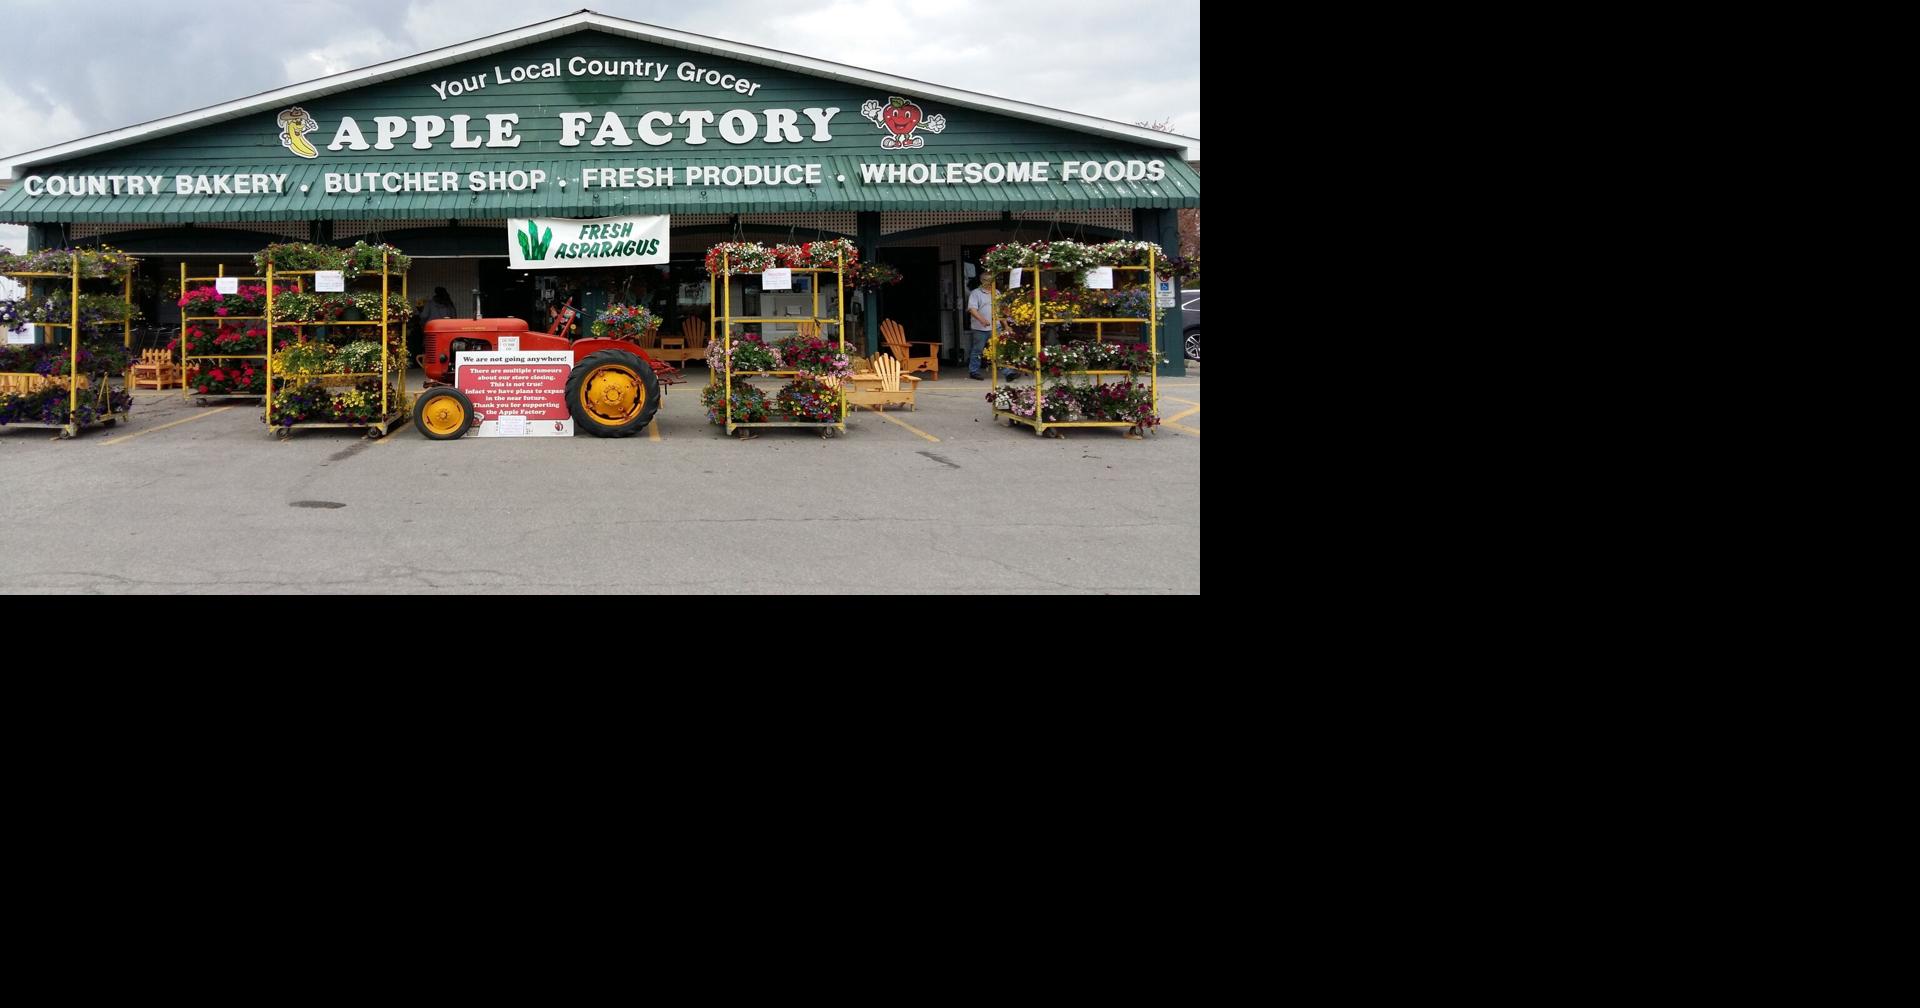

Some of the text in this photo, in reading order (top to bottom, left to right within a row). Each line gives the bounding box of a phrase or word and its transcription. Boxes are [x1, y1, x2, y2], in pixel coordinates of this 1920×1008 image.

[431, 56, 761, 101] Your Local Country Grocer
[327, 107, 841, 151] APPLE FACTORY
[23, 159, 1166, 197] COUNTRY BAKERY BUTCHER SHOP FRESH PRODUCE WHOLESOME FOODS
[578, 222, 634, 240] FRESH
[553, 238, 660, 259] ASPARAGUS
[526, 355, 567, 363] anywhere!
